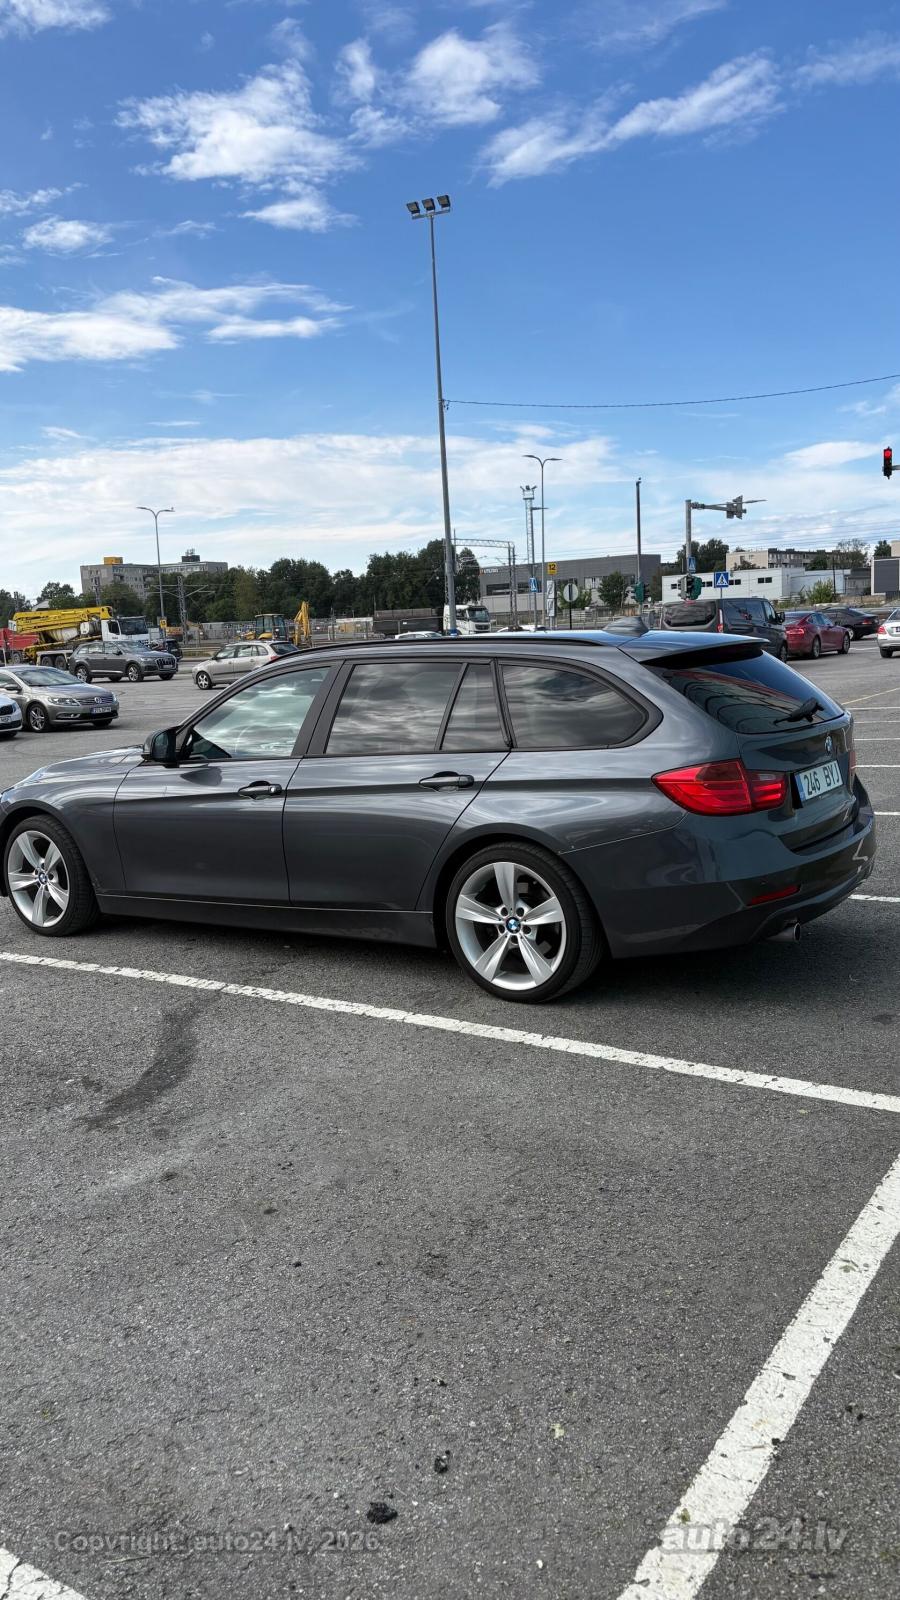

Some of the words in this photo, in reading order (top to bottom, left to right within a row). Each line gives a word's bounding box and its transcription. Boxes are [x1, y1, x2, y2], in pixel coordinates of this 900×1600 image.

[548, 563, 556, 571] 12
[804, 771, 821, 795] 246
[823, 763, 839, 786] BYJ
